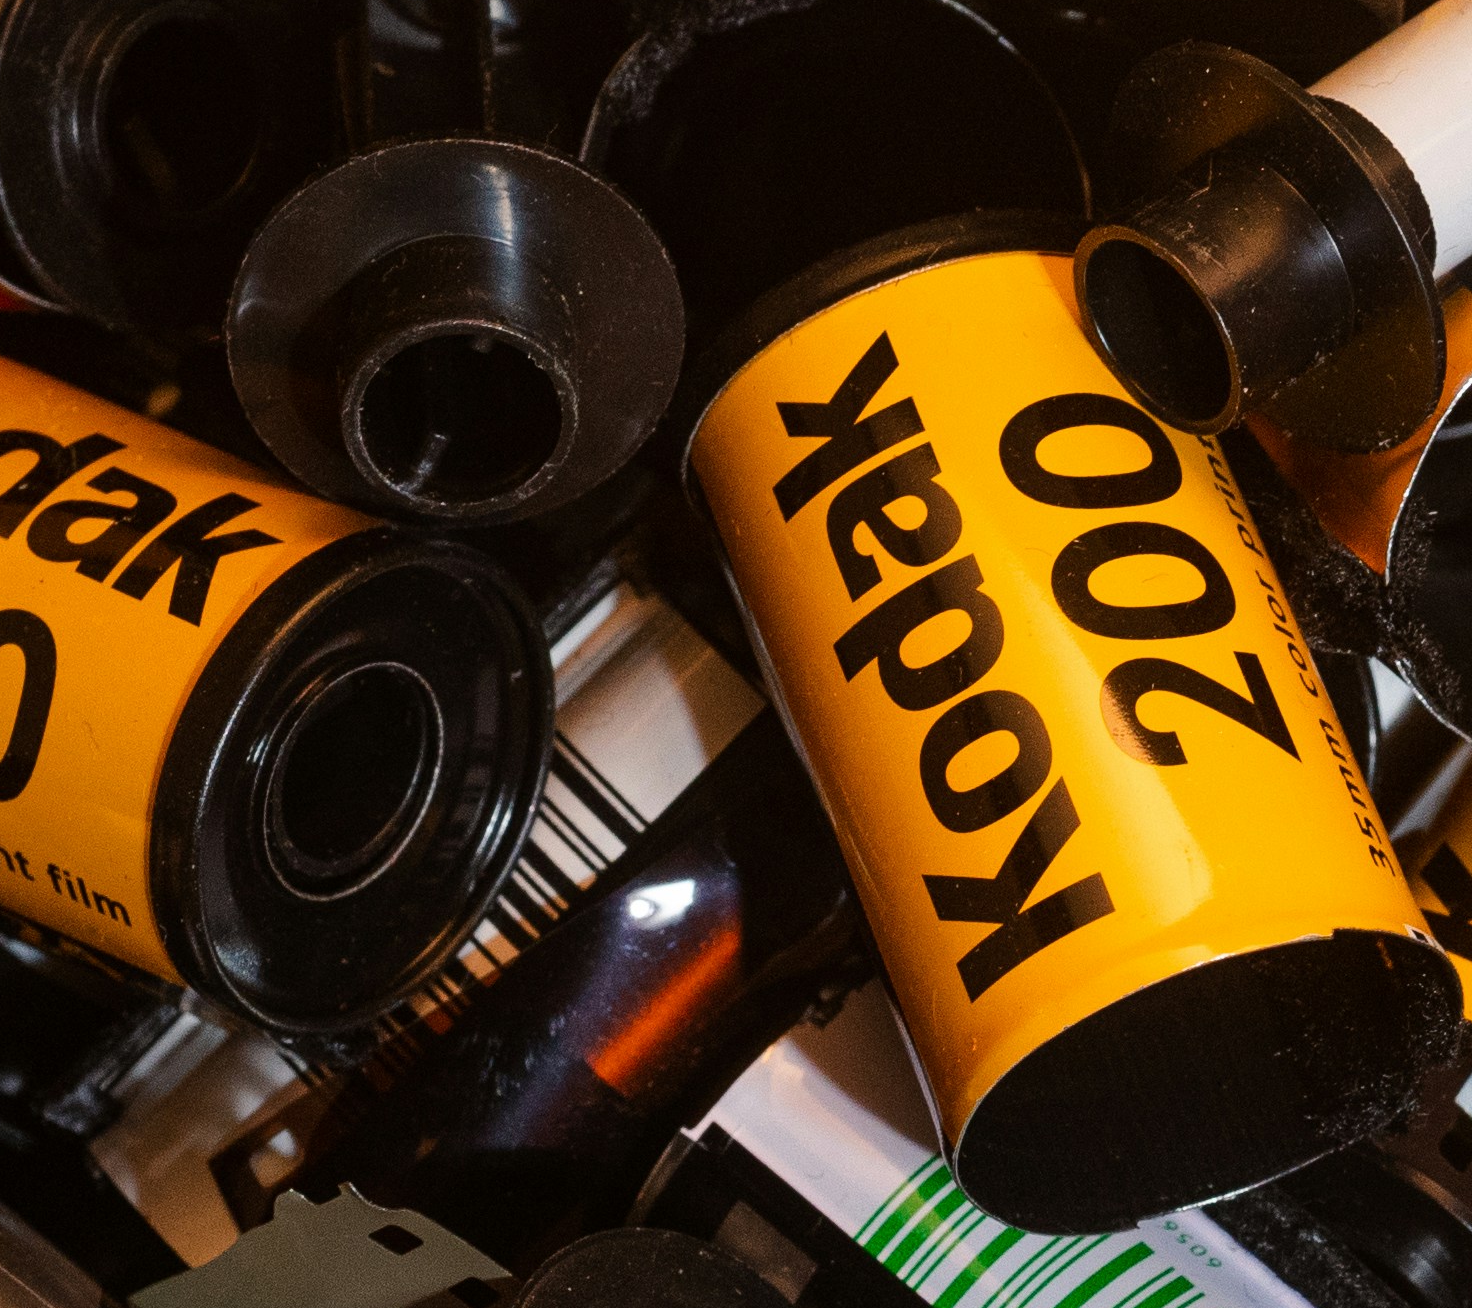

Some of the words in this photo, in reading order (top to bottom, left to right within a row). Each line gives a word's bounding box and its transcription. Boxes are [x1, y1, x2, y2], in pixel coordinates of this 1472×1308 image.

[999, 391, 1302, 768] 200
[1253, 570, 1321, 699] color
[771, 329, 1116, 1004] Kodak
[1318, 717, 1397, 879] 35mm
[46, 861, 133, 928] film
